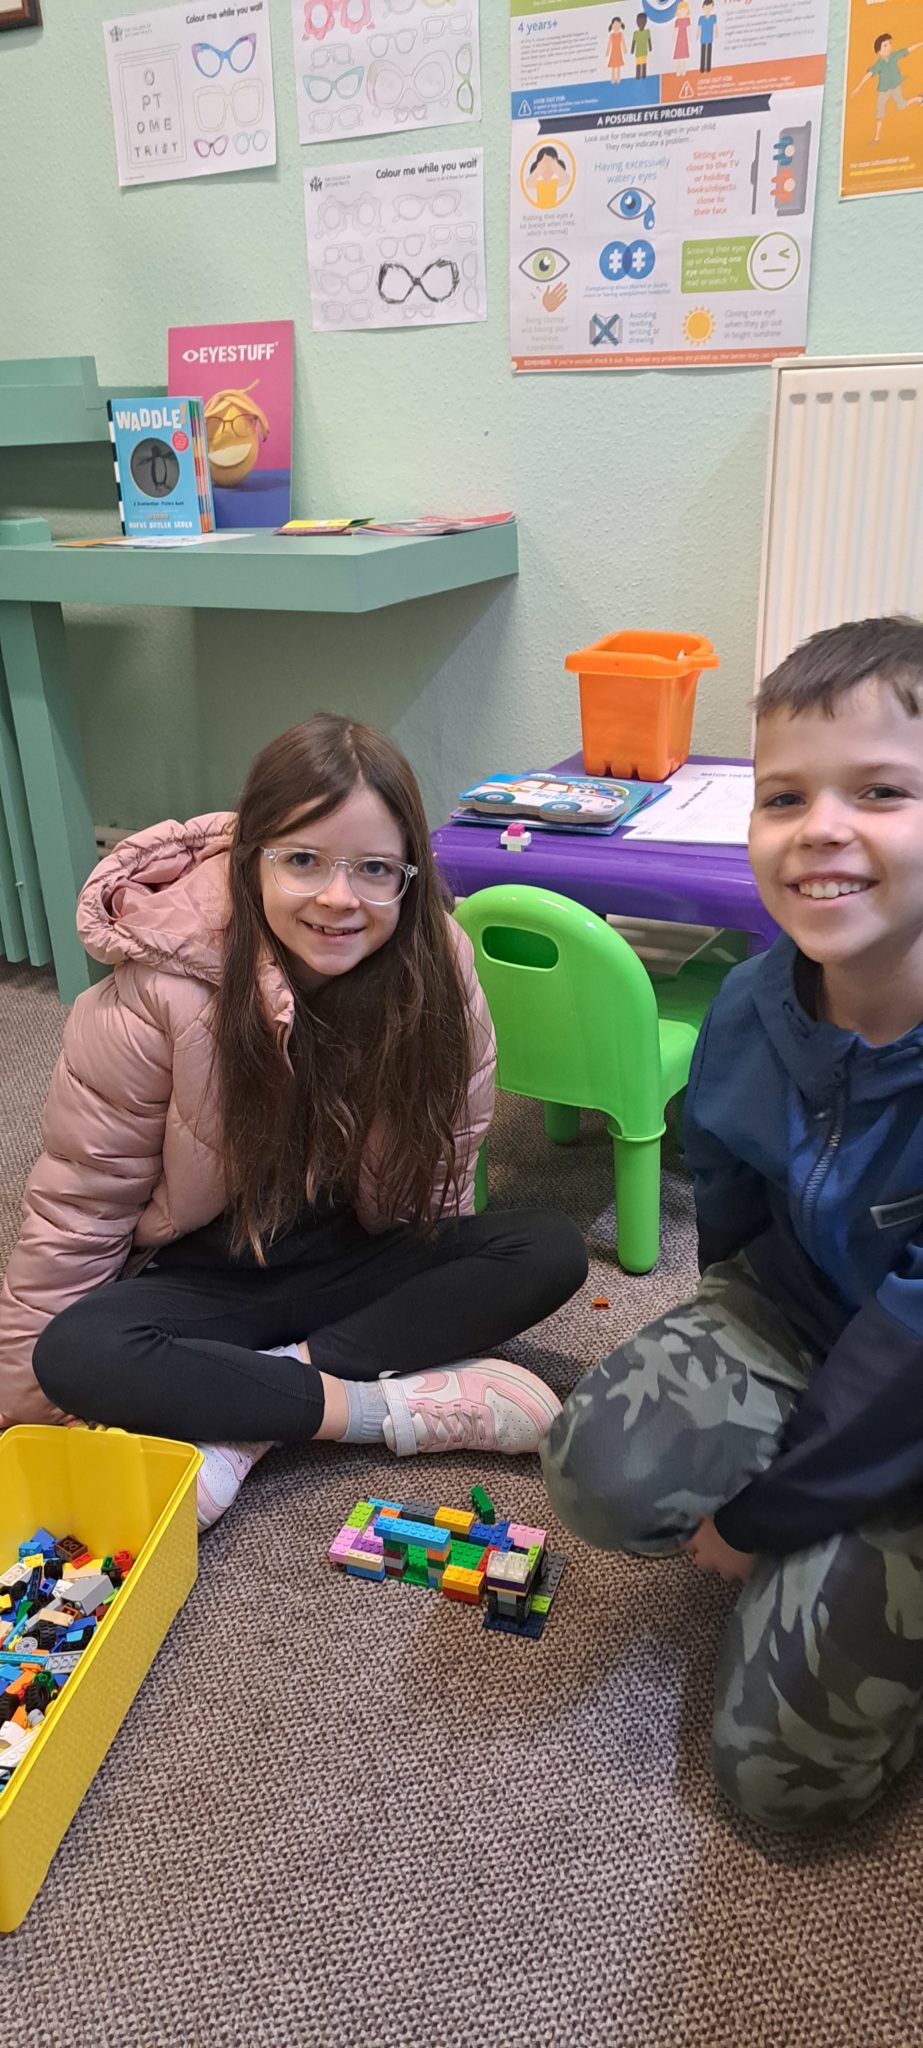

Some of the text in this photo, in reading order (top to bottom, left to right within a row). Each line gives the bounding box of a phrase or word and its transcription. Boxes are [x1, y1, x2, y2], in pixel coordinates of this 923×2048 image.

[186, 14, 205, 24] Colour
[219, 7, 235, 18] while
[237, 7, 248, 17] you
[250, 2, 263, 12] wait
[518, 20, 558, 35] 4 years+
[597, 106, 704, 127] A POSSIBLE EYE PROBLEM?
[599, 134, 609, 142] out
[611, 133, 619, 141] for
[620, 131, 636, 140] these
[638, 129, 662, 138] warning
[686, 125, 700, 134] your
[606, 143, 620, 152] They
[621, 142, 634, 150] may
[636, 140, 658, 148] indicate
[693, 149, 735, 161] Sitting very
[376, 158, 477, 179] Colour me while you wait
[594, 158, 670, 173] Having excessively
[686, 164, 704, 172] close
[716, 162, 727, 170] the
[729, 160, 740, 168] TV
[607, 172, 657, 185] watery eyes
[704, 172, 731, 183] holding
[694, 206, 727, 216] their face
[704, 256, 728, 265] closing
[630, 311, 657, 320] Avoiding
[200, 344, 275, 364] EYESTUFF
[116, 402, 187, 432] WADDLE!
